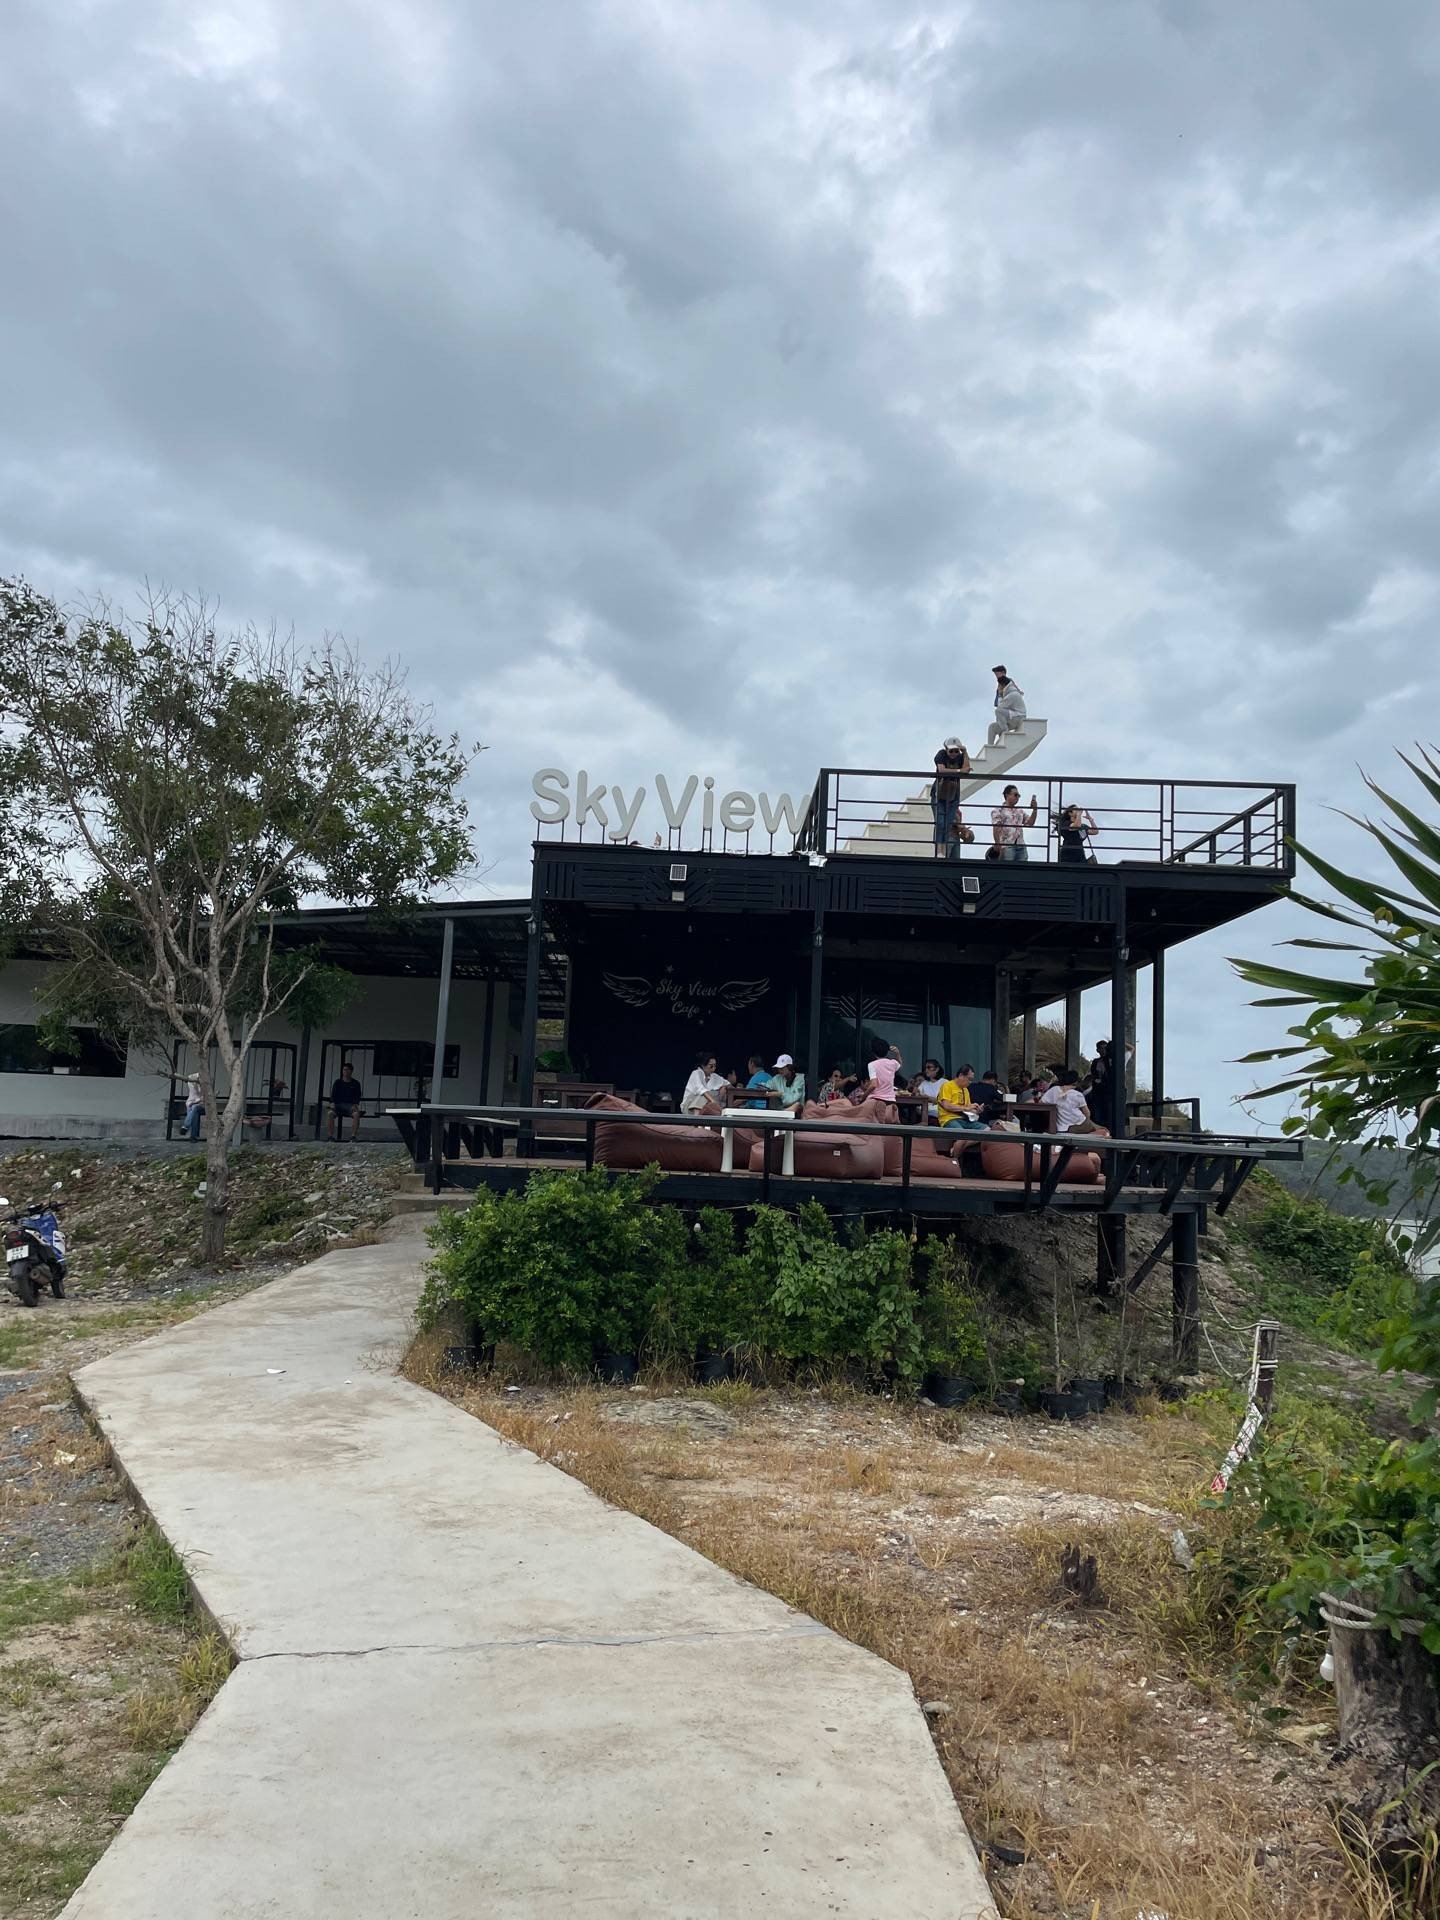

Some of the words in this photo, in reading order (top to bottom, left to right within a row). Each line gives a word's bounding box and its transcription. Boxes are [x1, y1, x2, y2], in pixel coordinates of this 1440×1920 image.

[530, 768, 646, 840] Sky
[655, 774, 812, 834] View
[656, 978, 682, 1000] Sky
